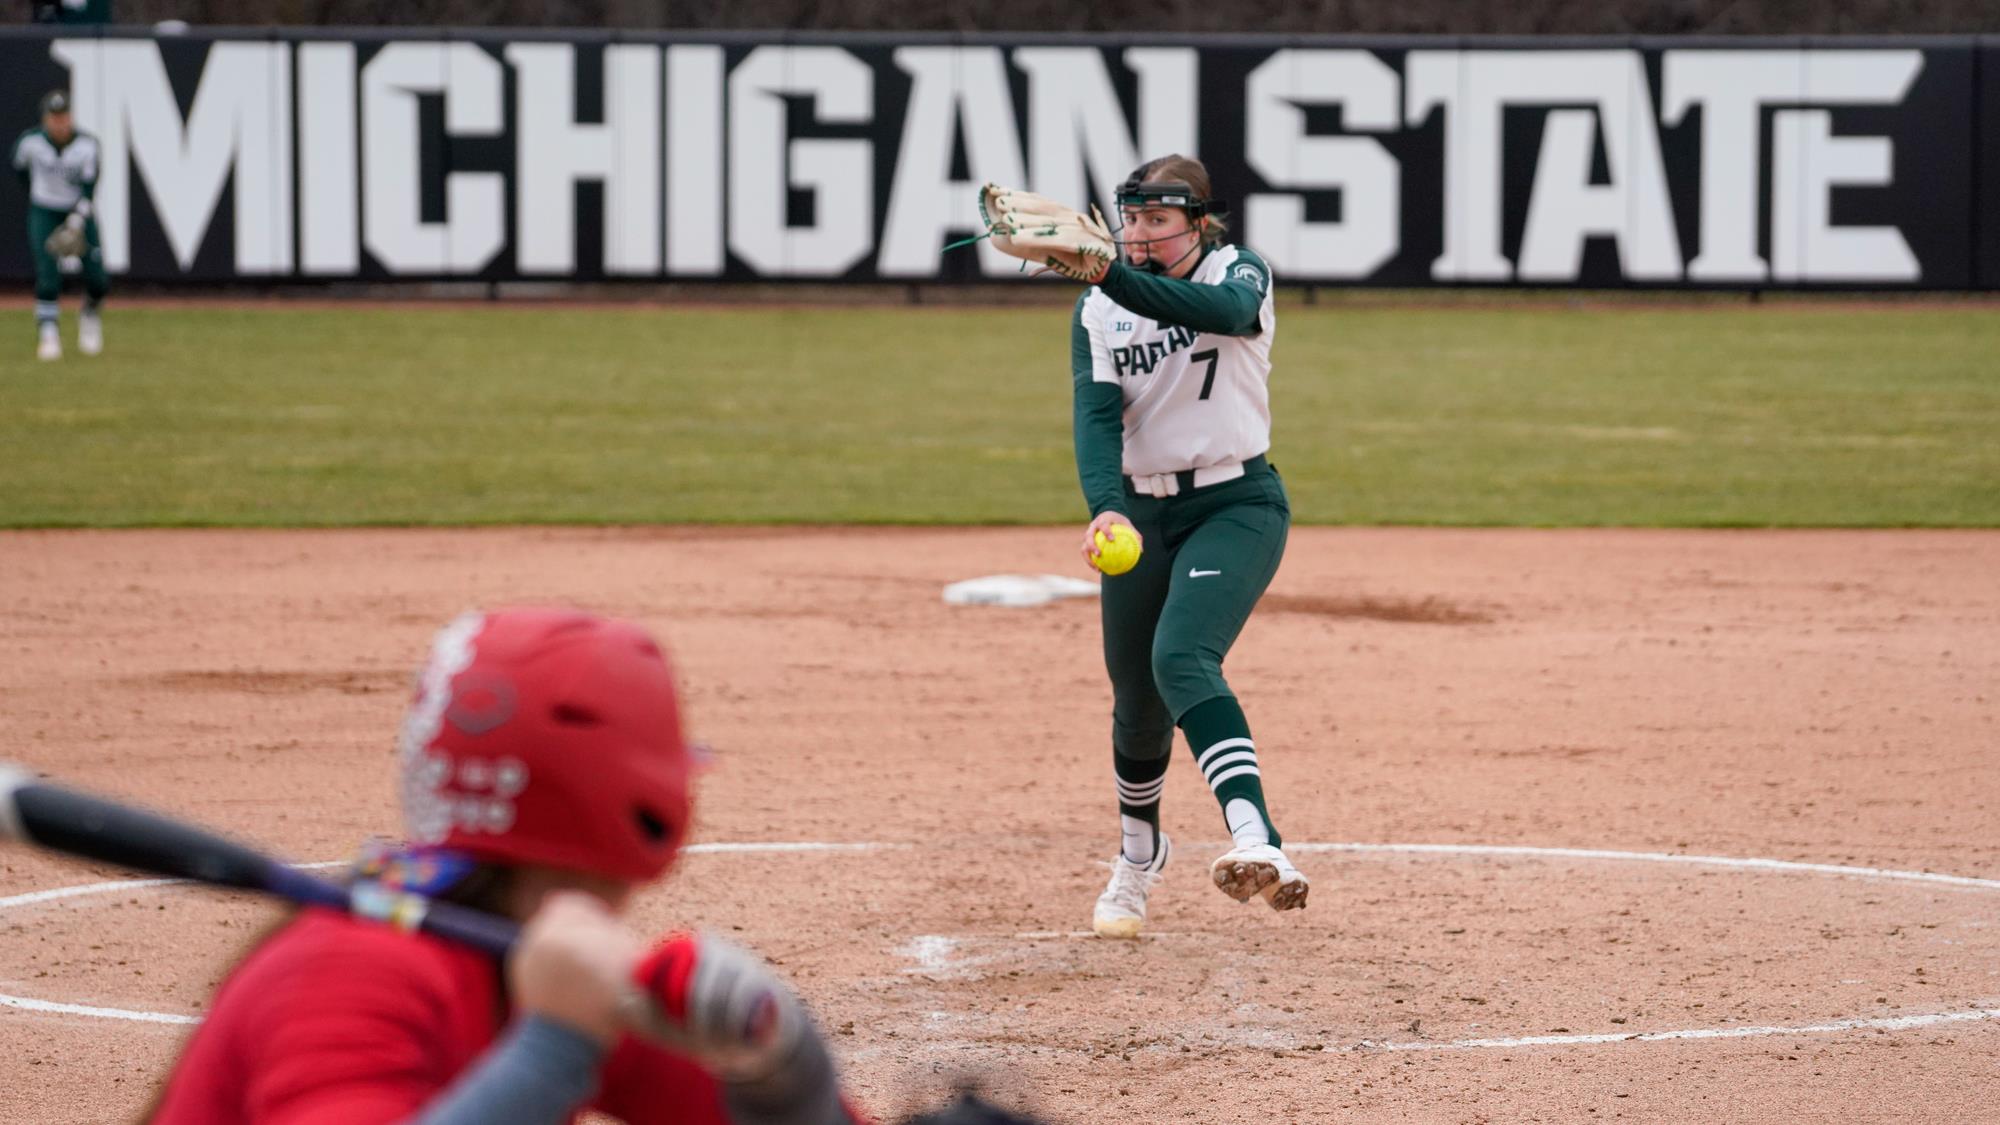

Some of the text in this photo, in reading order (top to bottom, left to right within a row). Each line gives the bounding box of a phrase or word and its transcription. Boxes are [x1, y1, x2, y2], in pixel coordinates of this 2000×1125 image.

[50, 39, 1924, 281] MICHIGAN STATE
[1190, 347, 1219, 401] 7
